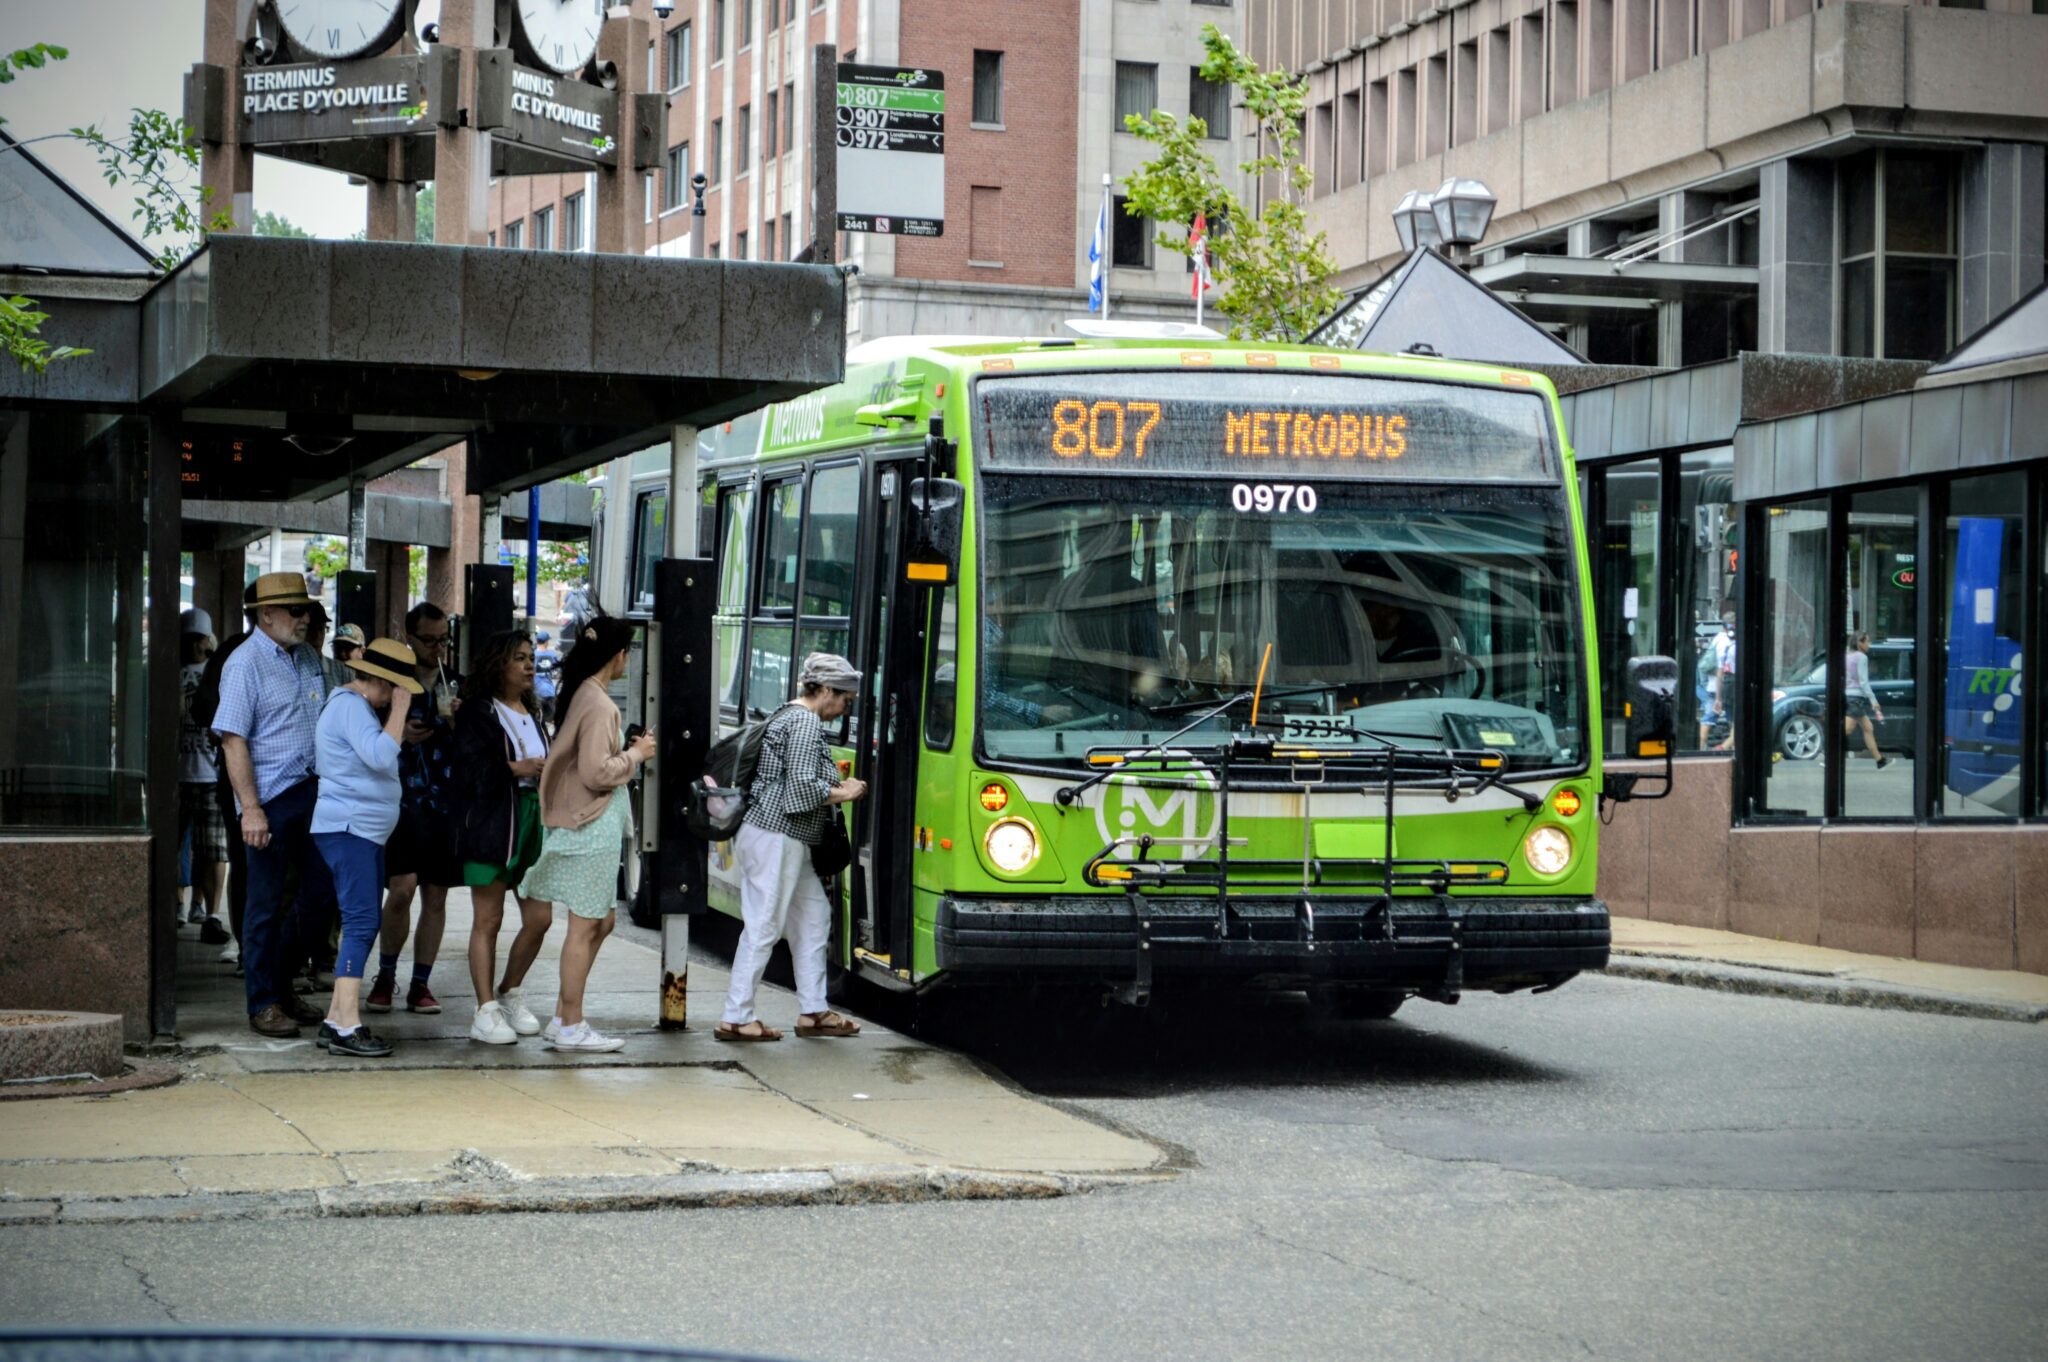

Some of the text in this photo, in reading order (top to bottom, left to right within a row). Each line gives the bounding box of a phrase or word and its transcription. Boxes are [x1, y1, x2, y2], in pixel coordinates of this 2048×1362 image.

[243, 66, 336, 92] TERMINUS
[512, 69, 555, 98] MINUS
[243, 83, 409, 114] PLACE D'YOUVILLE
[855, 87, 889, 107] 807
[531, 96, 602, 132] D'YOUVILLE
[855, 108, 889, 129] 907
[855, 129, 889, 150] 972
[844, 220, 868, 230] 2441
[1052, 399, 1162, 458] 807
[1225, 411, 1408, 460] METROBUS
[880, 472, 896, 497] 0970
[1231, 483, 1318, 515] 0970
[1288, 718, 1347, 738] 3235
